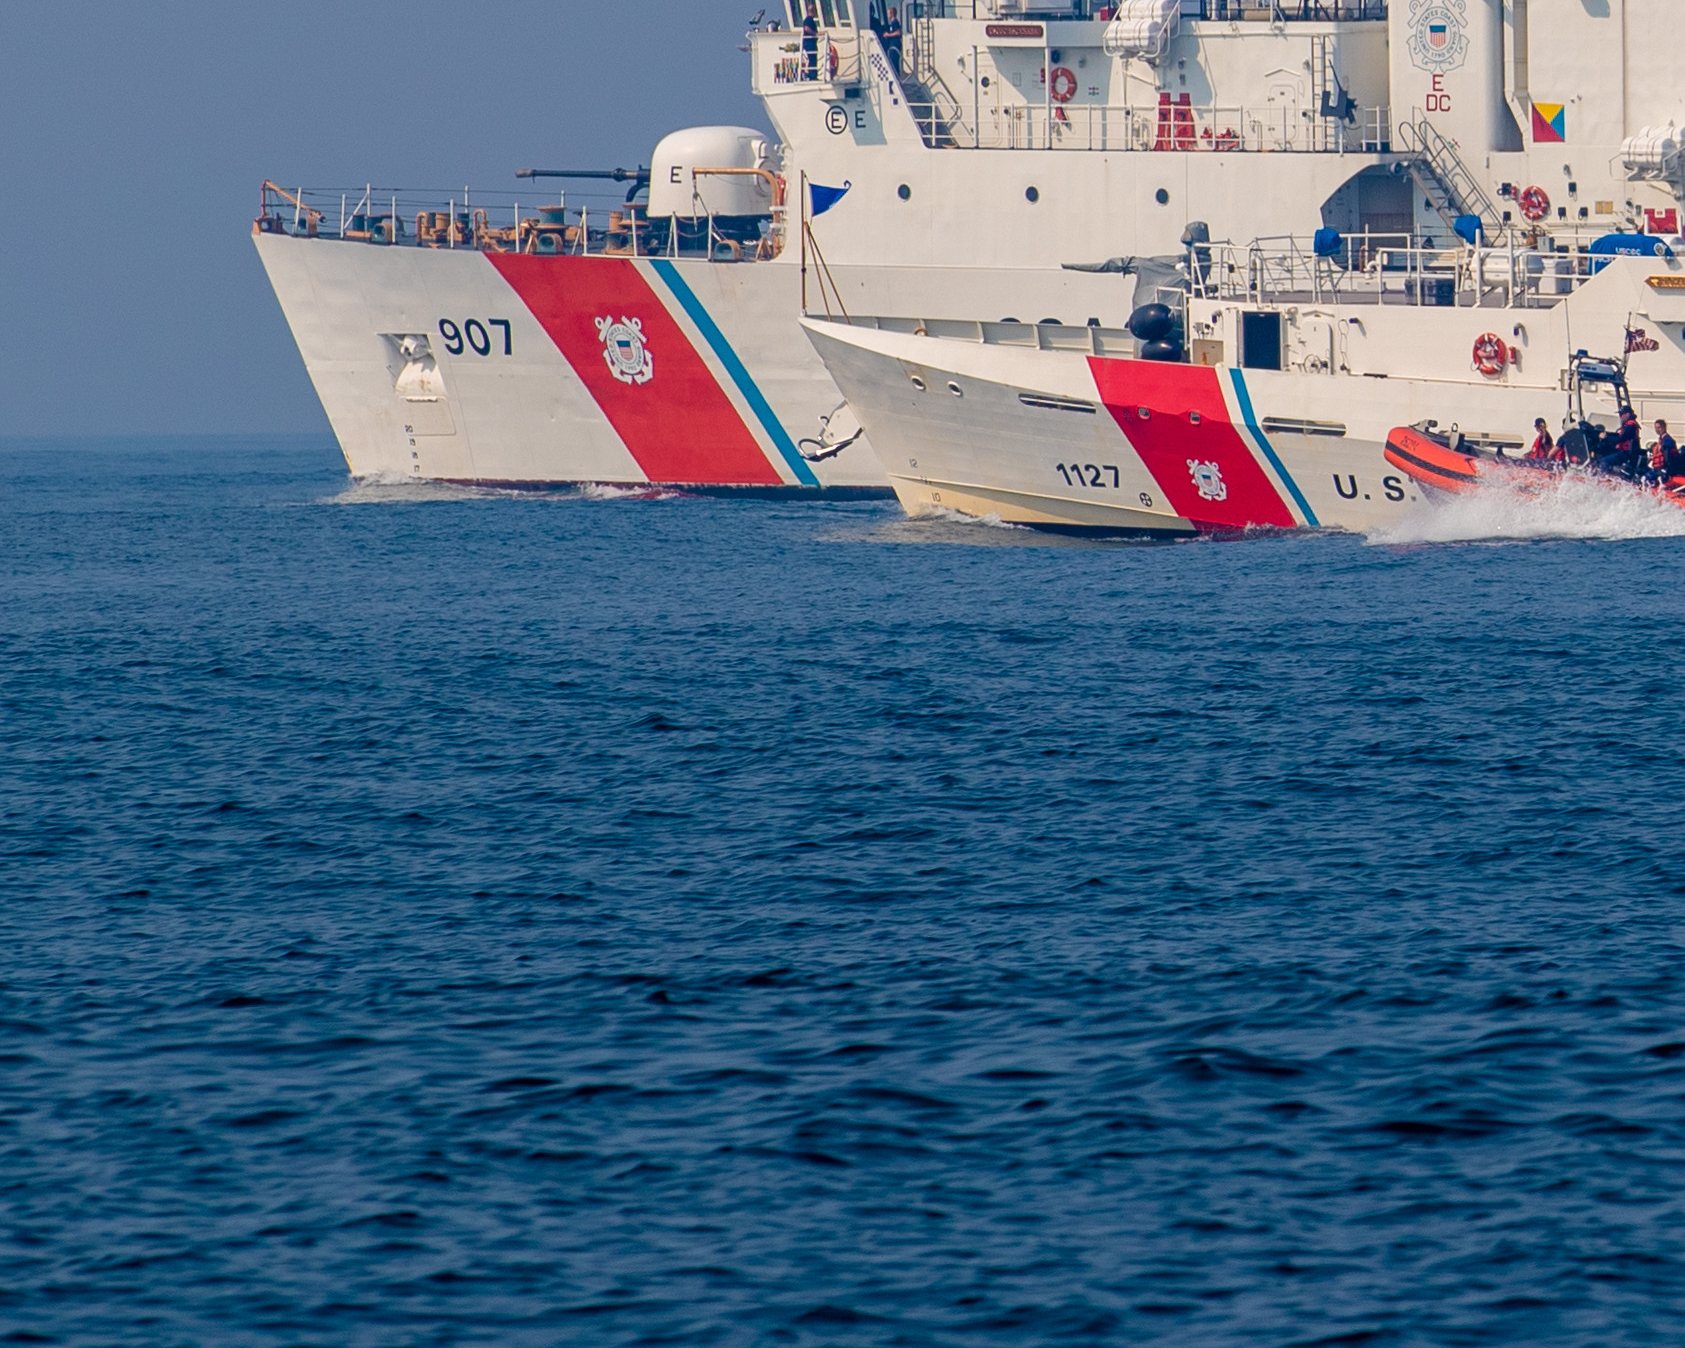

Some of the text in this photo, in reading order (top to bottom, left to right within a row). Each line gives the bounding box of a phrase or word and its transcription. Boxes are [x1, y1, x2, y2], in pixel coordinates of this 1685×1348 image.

[1432, 74, 1444, 92] E
[1426, 94, 1451, 112] DC
[831, 110, 866, 129] E E
[670, 166, 683, 184] E
[438, 318, 512, 356] 907
[1056, 463, 1119, 488] 1127
